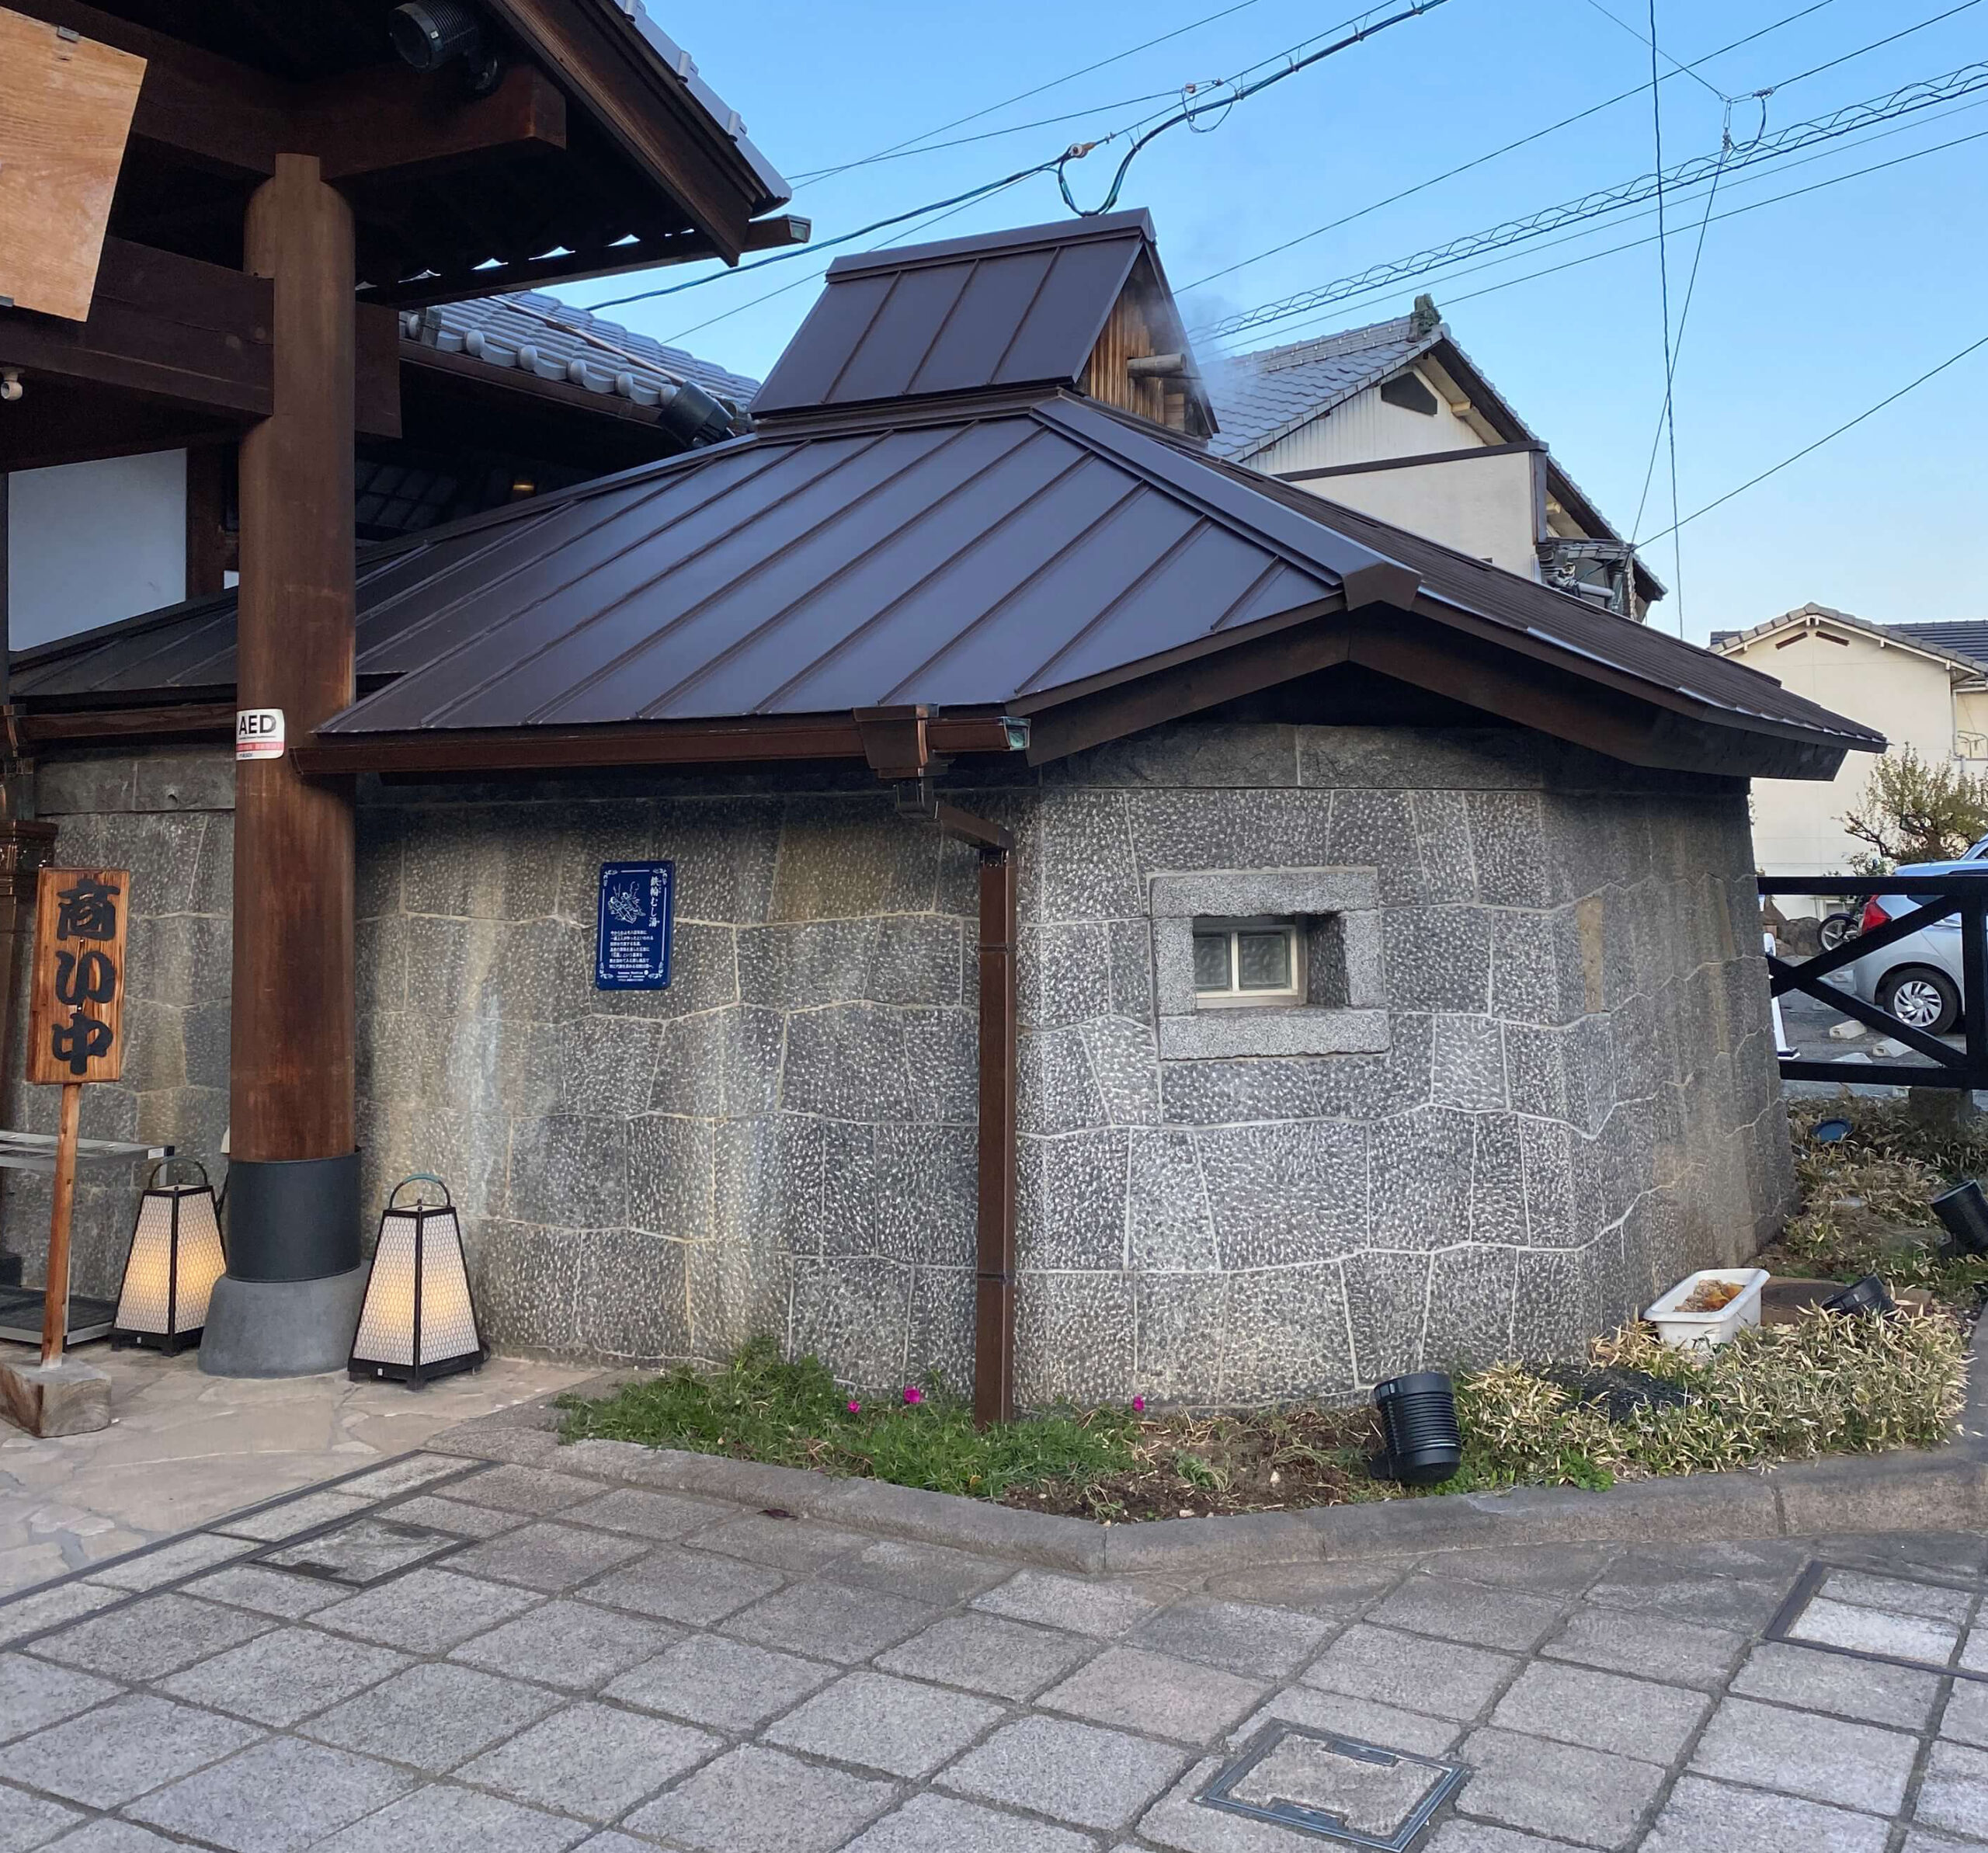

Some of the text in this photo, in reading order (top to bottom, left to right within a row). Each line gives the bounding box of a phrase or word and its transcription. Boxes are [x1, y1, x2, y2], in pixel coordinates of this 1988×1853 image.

[238, 714, 276, 735] AED
[51, 878, 120, 1076] 商い中
